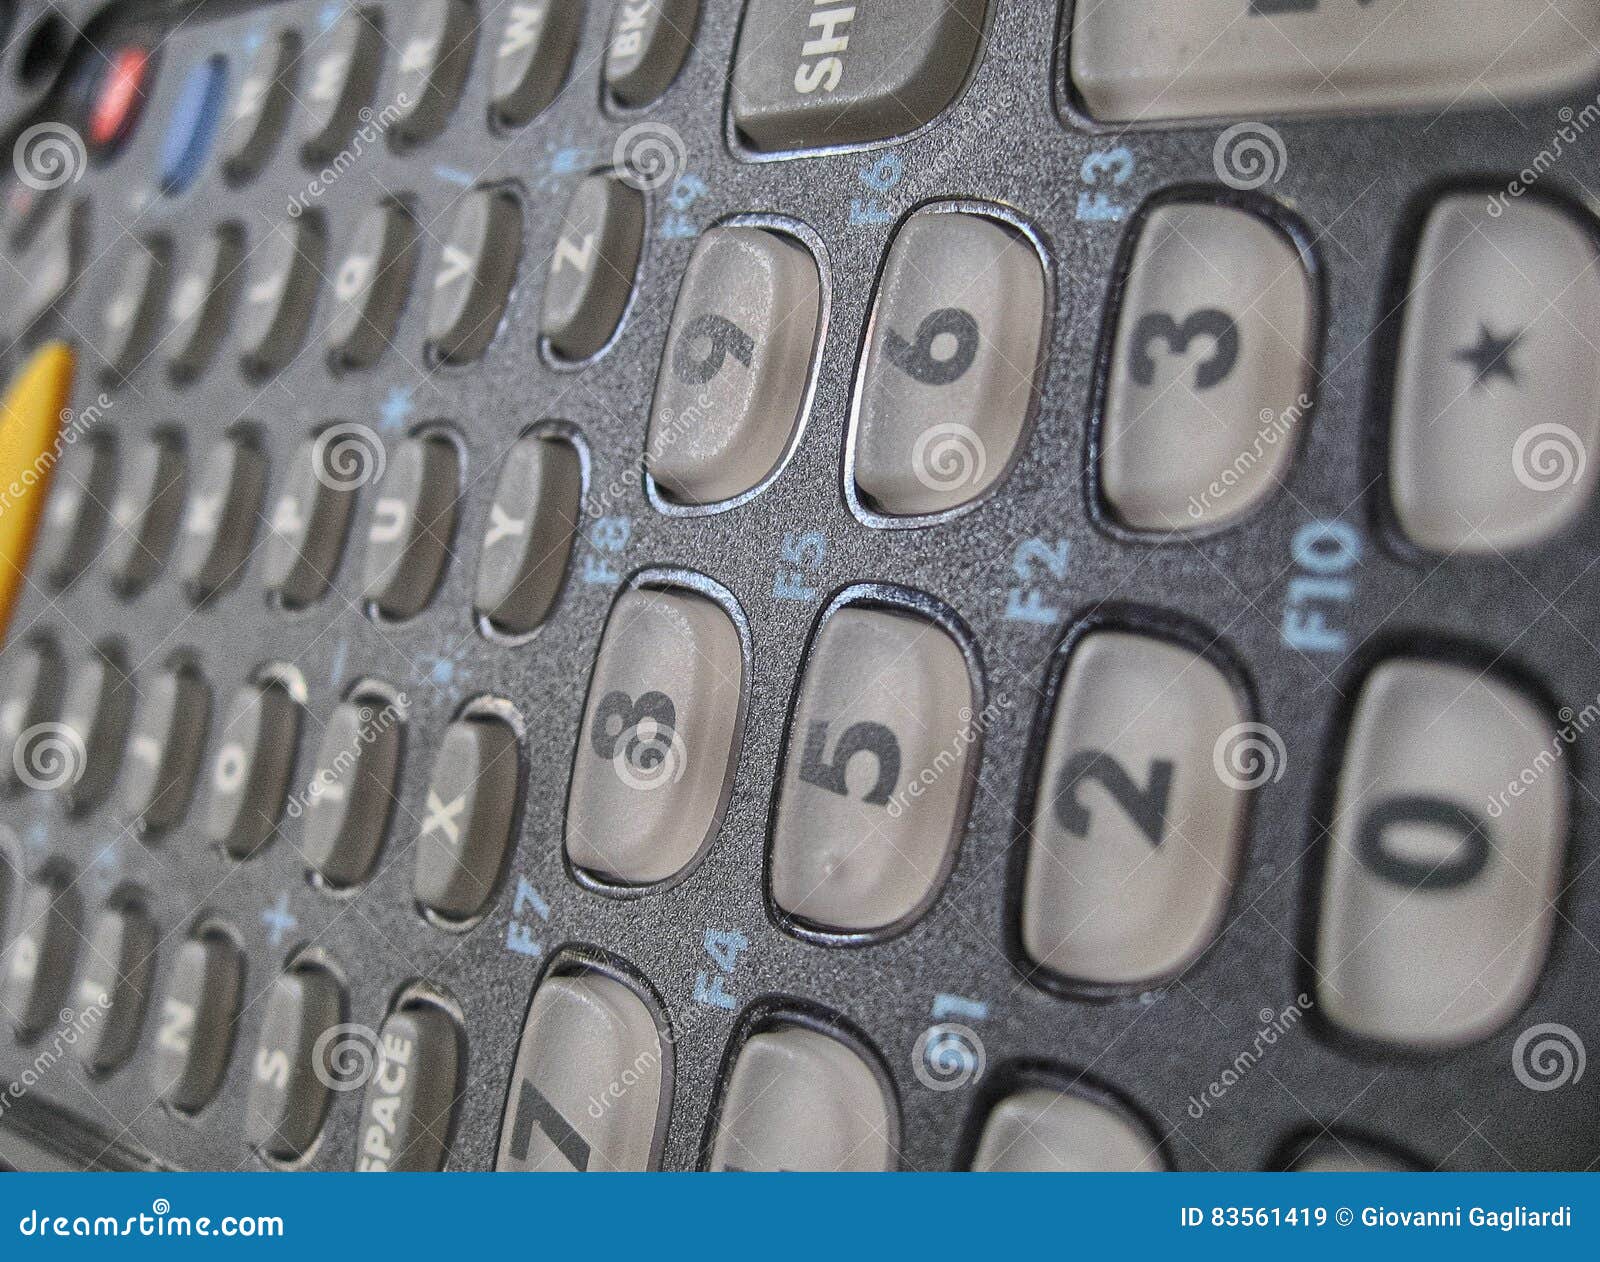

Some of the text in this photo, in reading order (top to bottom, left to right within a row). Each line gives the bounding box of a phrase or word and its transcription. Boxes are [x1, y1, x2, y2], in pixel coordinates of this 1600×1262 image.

[793, 0, 857, 94] SH
[662, 171, 710, 239] F9
[850, 152, 902, 225] F6
[1075, 147, 1135, 222] F3
[434, 245, 474, 289] V
[551, 233, 594, 274] Z
[672, 313, 754, 386] 9
[881, 307, 980, 387] 6
[1129, 308, 1240, 391] 3
[368, 499, 406, 543] U
[484, 502, 527, 549] Y
[583, 514, 632, 585] F8
[771, 530, 827, 602] F5
[1003, 536, 1071, 625] F2
[1281, 519, 1363, 652] F10
[590, 690, 677, 770] 8
[800, 719, 901, 806] 5
[421, 788, 466, 844] X
[1054, 747, 1175, 851] 2
[1354, 793, 1491, 892] 0
[505, 875, 551, 958] F7
[694, 928, 750, 1010] F4
[159, 1000, 194, 1051] N
[257, 1046, 290, 1089] S
[508, 1077, 592, 1172] 7
